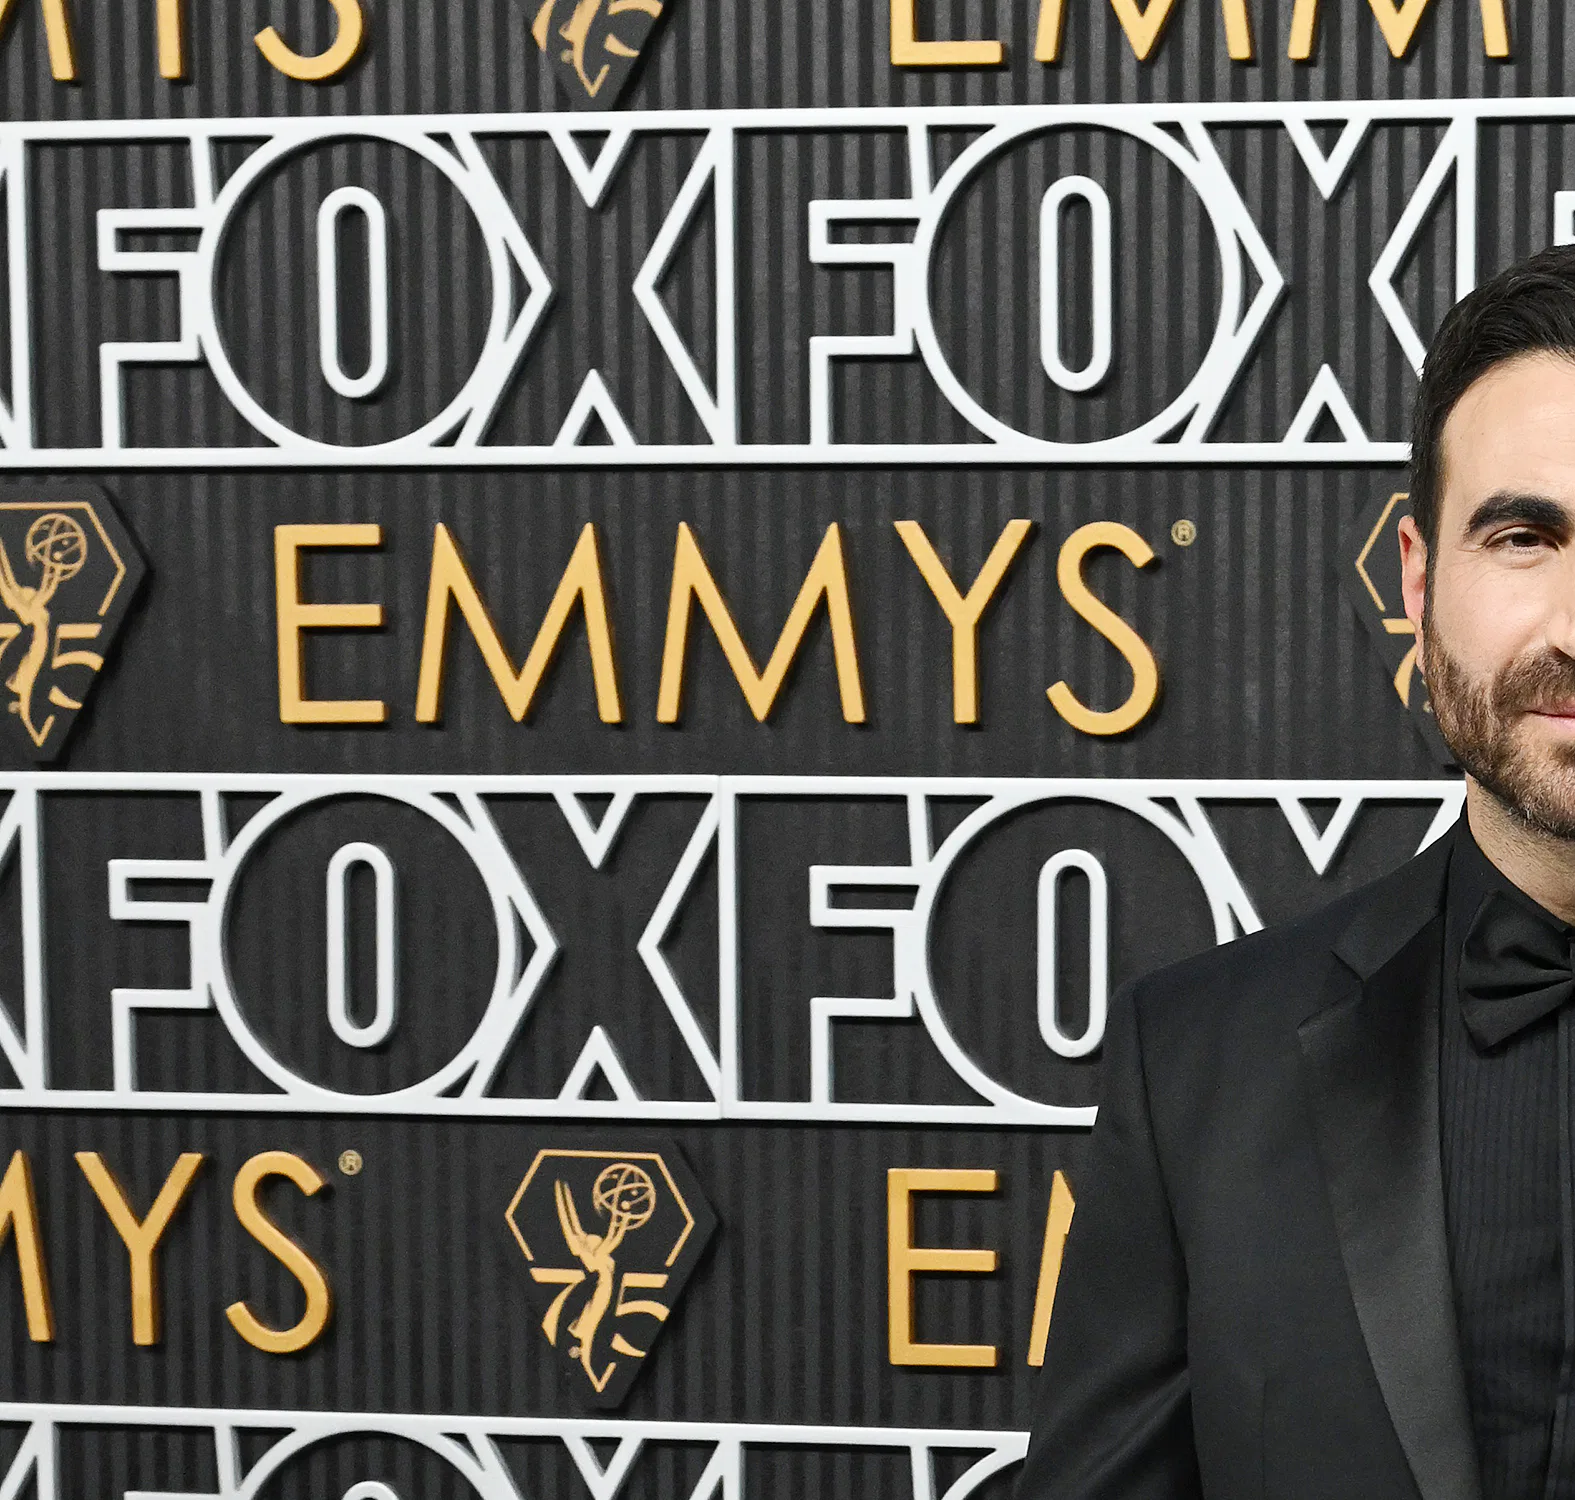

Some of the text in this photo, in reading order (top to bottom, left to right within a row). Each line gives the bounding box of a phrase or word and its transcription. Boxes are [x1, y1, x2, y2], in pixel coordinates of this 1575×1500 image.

[6, 108, 730, 467] FOX
[714, 97, 1480, 466] FOX
[18, 773, 738, 1119] FOX
